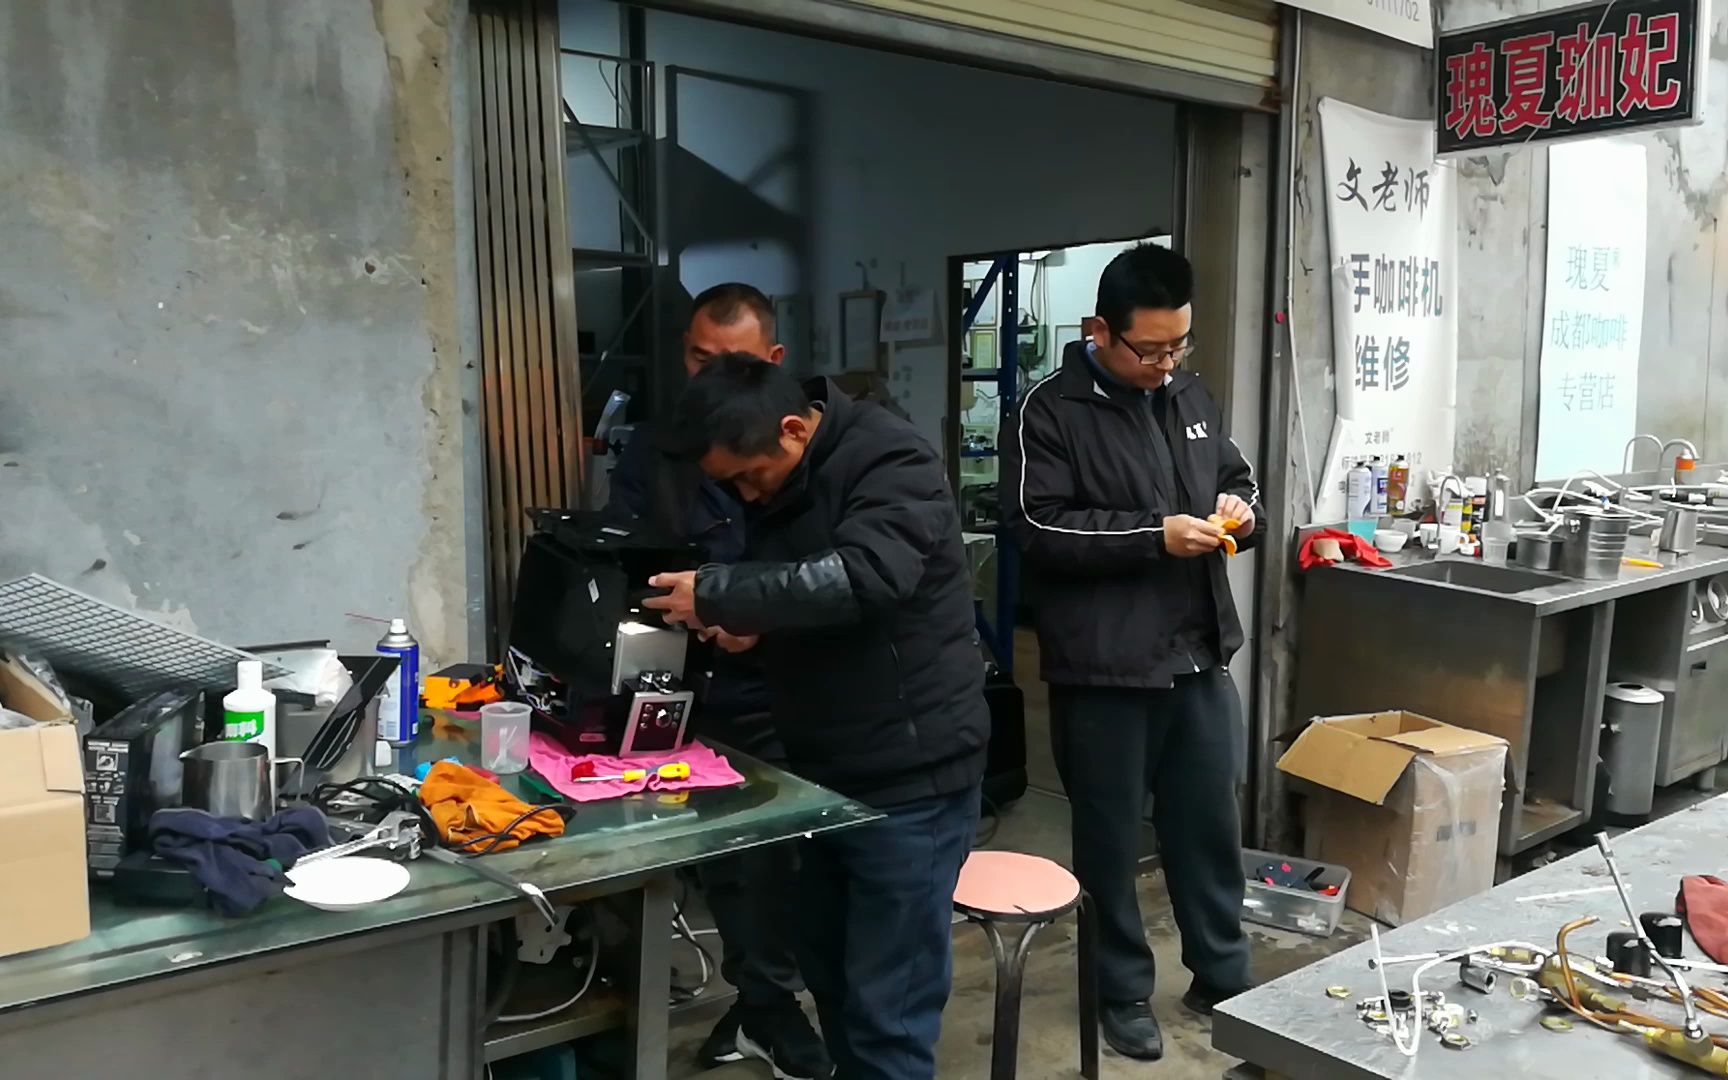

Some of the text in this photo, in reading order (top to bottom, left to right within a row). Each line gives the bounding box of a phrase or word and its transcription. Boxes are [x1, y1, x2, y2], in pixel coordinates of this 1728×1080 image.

[1445, 12, 1681, 140] 瑰夏珈妃
[1337, 157, 1429, 222] 文老师
[1341, 253, 1443, 318] 手咖啡机
[1565, 243, 1611, 292] 瑰夏
[1551, 310, 1628, 351] 成都咖啡
[1355, 335, 1411, 392] 维修
[1558, 371, 1616, 412] 专营店
